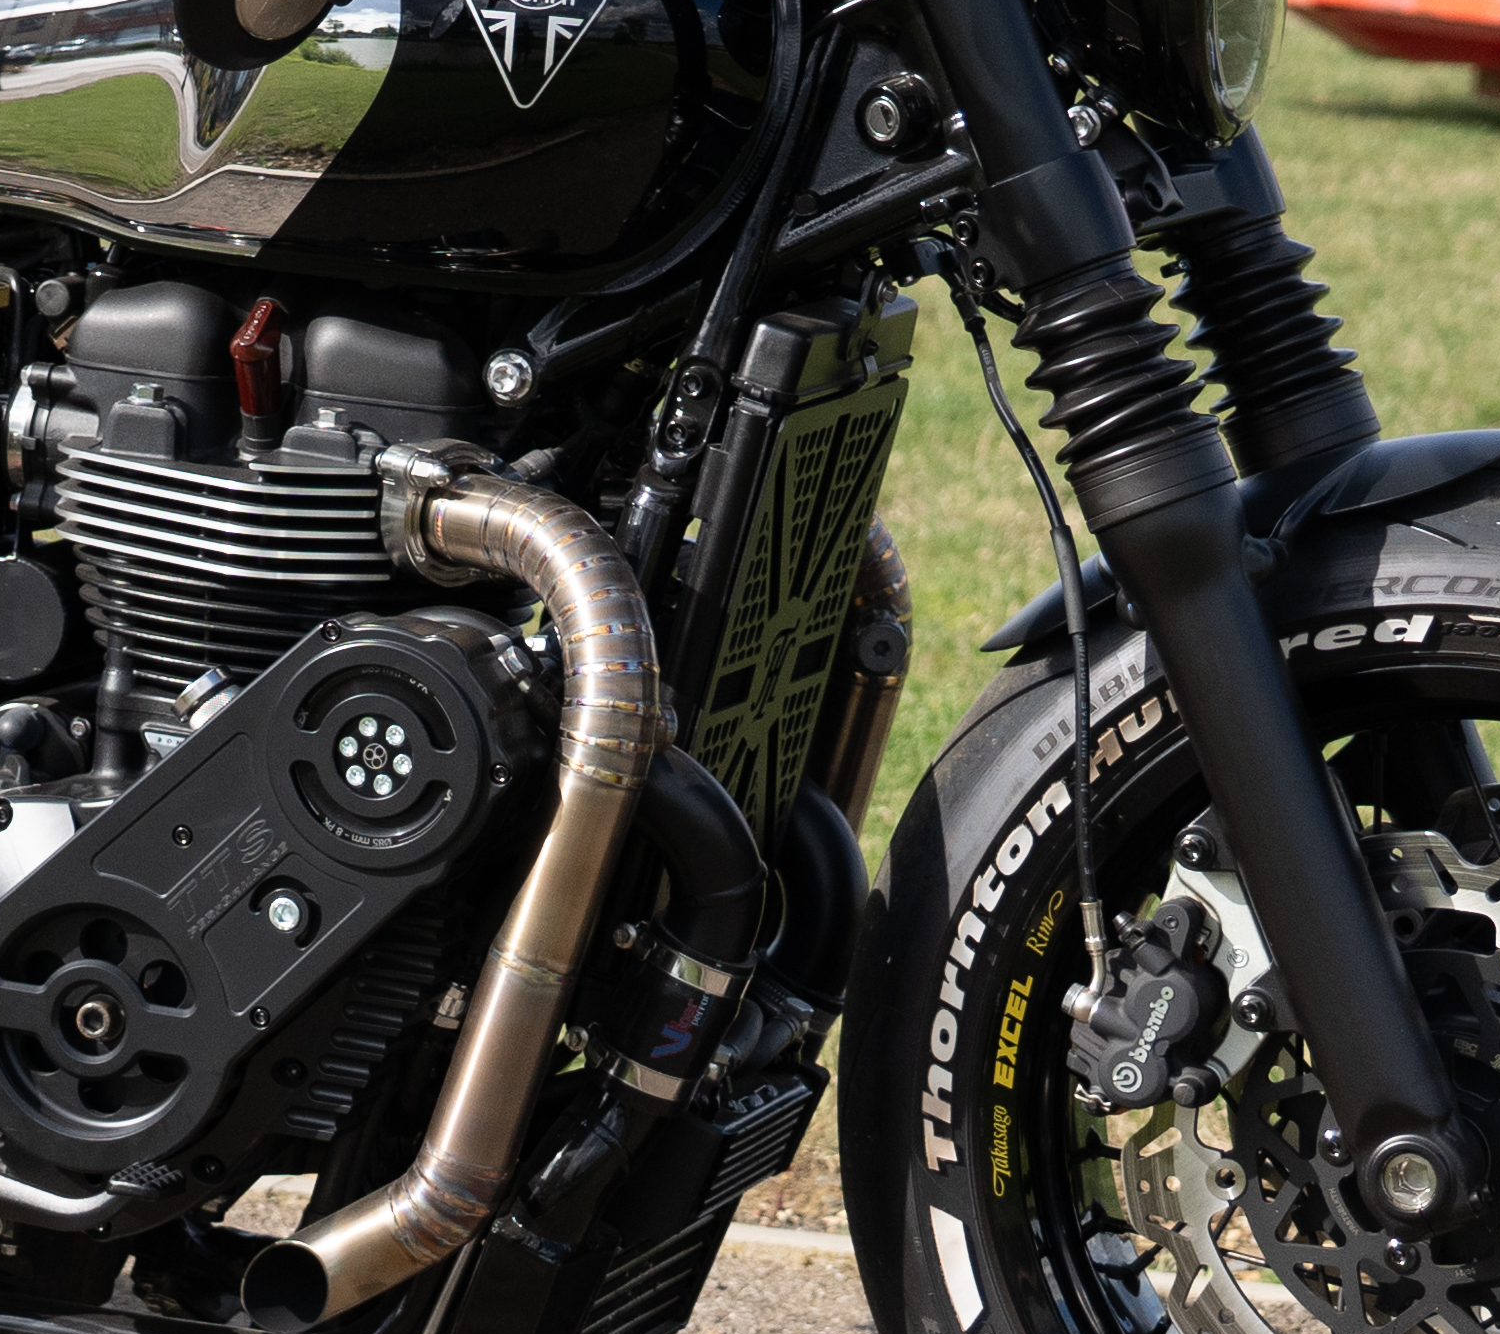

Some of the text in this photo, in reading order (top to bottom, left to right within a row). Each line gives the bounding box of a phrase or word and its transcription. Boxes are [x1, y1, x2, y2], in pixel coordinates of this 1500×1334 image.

[166, 818, 274, 923] TTS
[921, 779, 1072, 1172] Thornton
[1127, 985, 1175, 1064] brembo
[992, 889, 1064, 1197] Takasago EXCEL Rim
[1453, 1037, 1479, 1053] EBC
